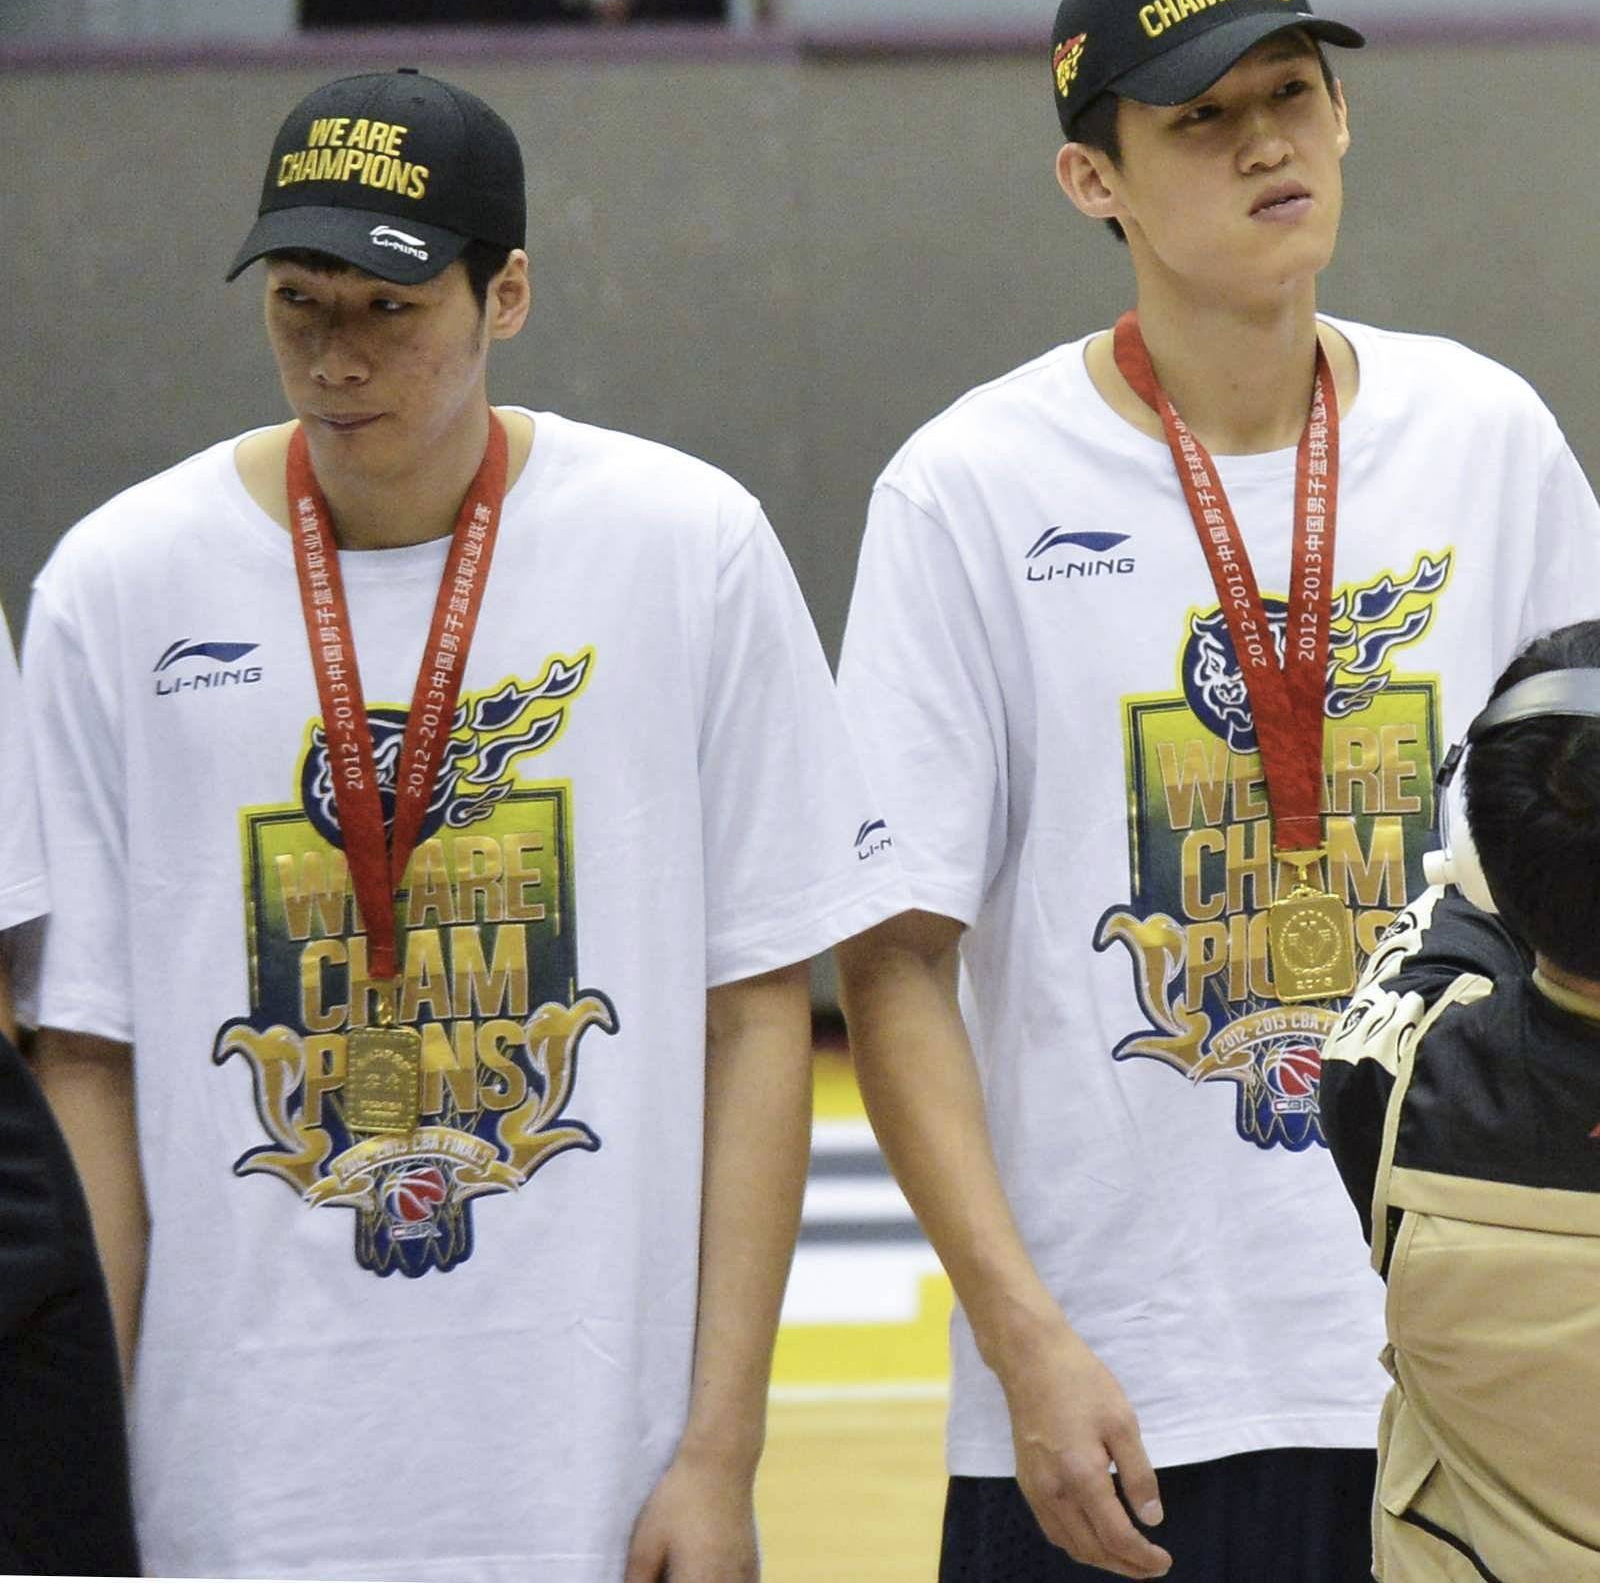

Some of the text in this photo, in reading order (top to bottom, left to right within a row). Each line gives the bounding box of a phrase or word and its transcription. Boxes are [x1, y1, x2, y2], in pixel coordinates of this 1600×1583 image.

[308, 118, 408, 157] WE ARE
[277, 148, 430, 201] CHAMPIONS
[371, 235, 429, 262] LI-NING
[1167, 401, 1267, 667] 2012-2013中国男子篮球职
[1298, 372, 1329, 661] 2012-2013中国男子篮球职业
[1026, 558, 1135, 582] LI-NING
[155, 666, 263, 697] LI-NING
[1322, 724, 1421, 815] RE
[274, 832, 546, 941] W ARE
[303, 1019, 529, 1129] PNS
